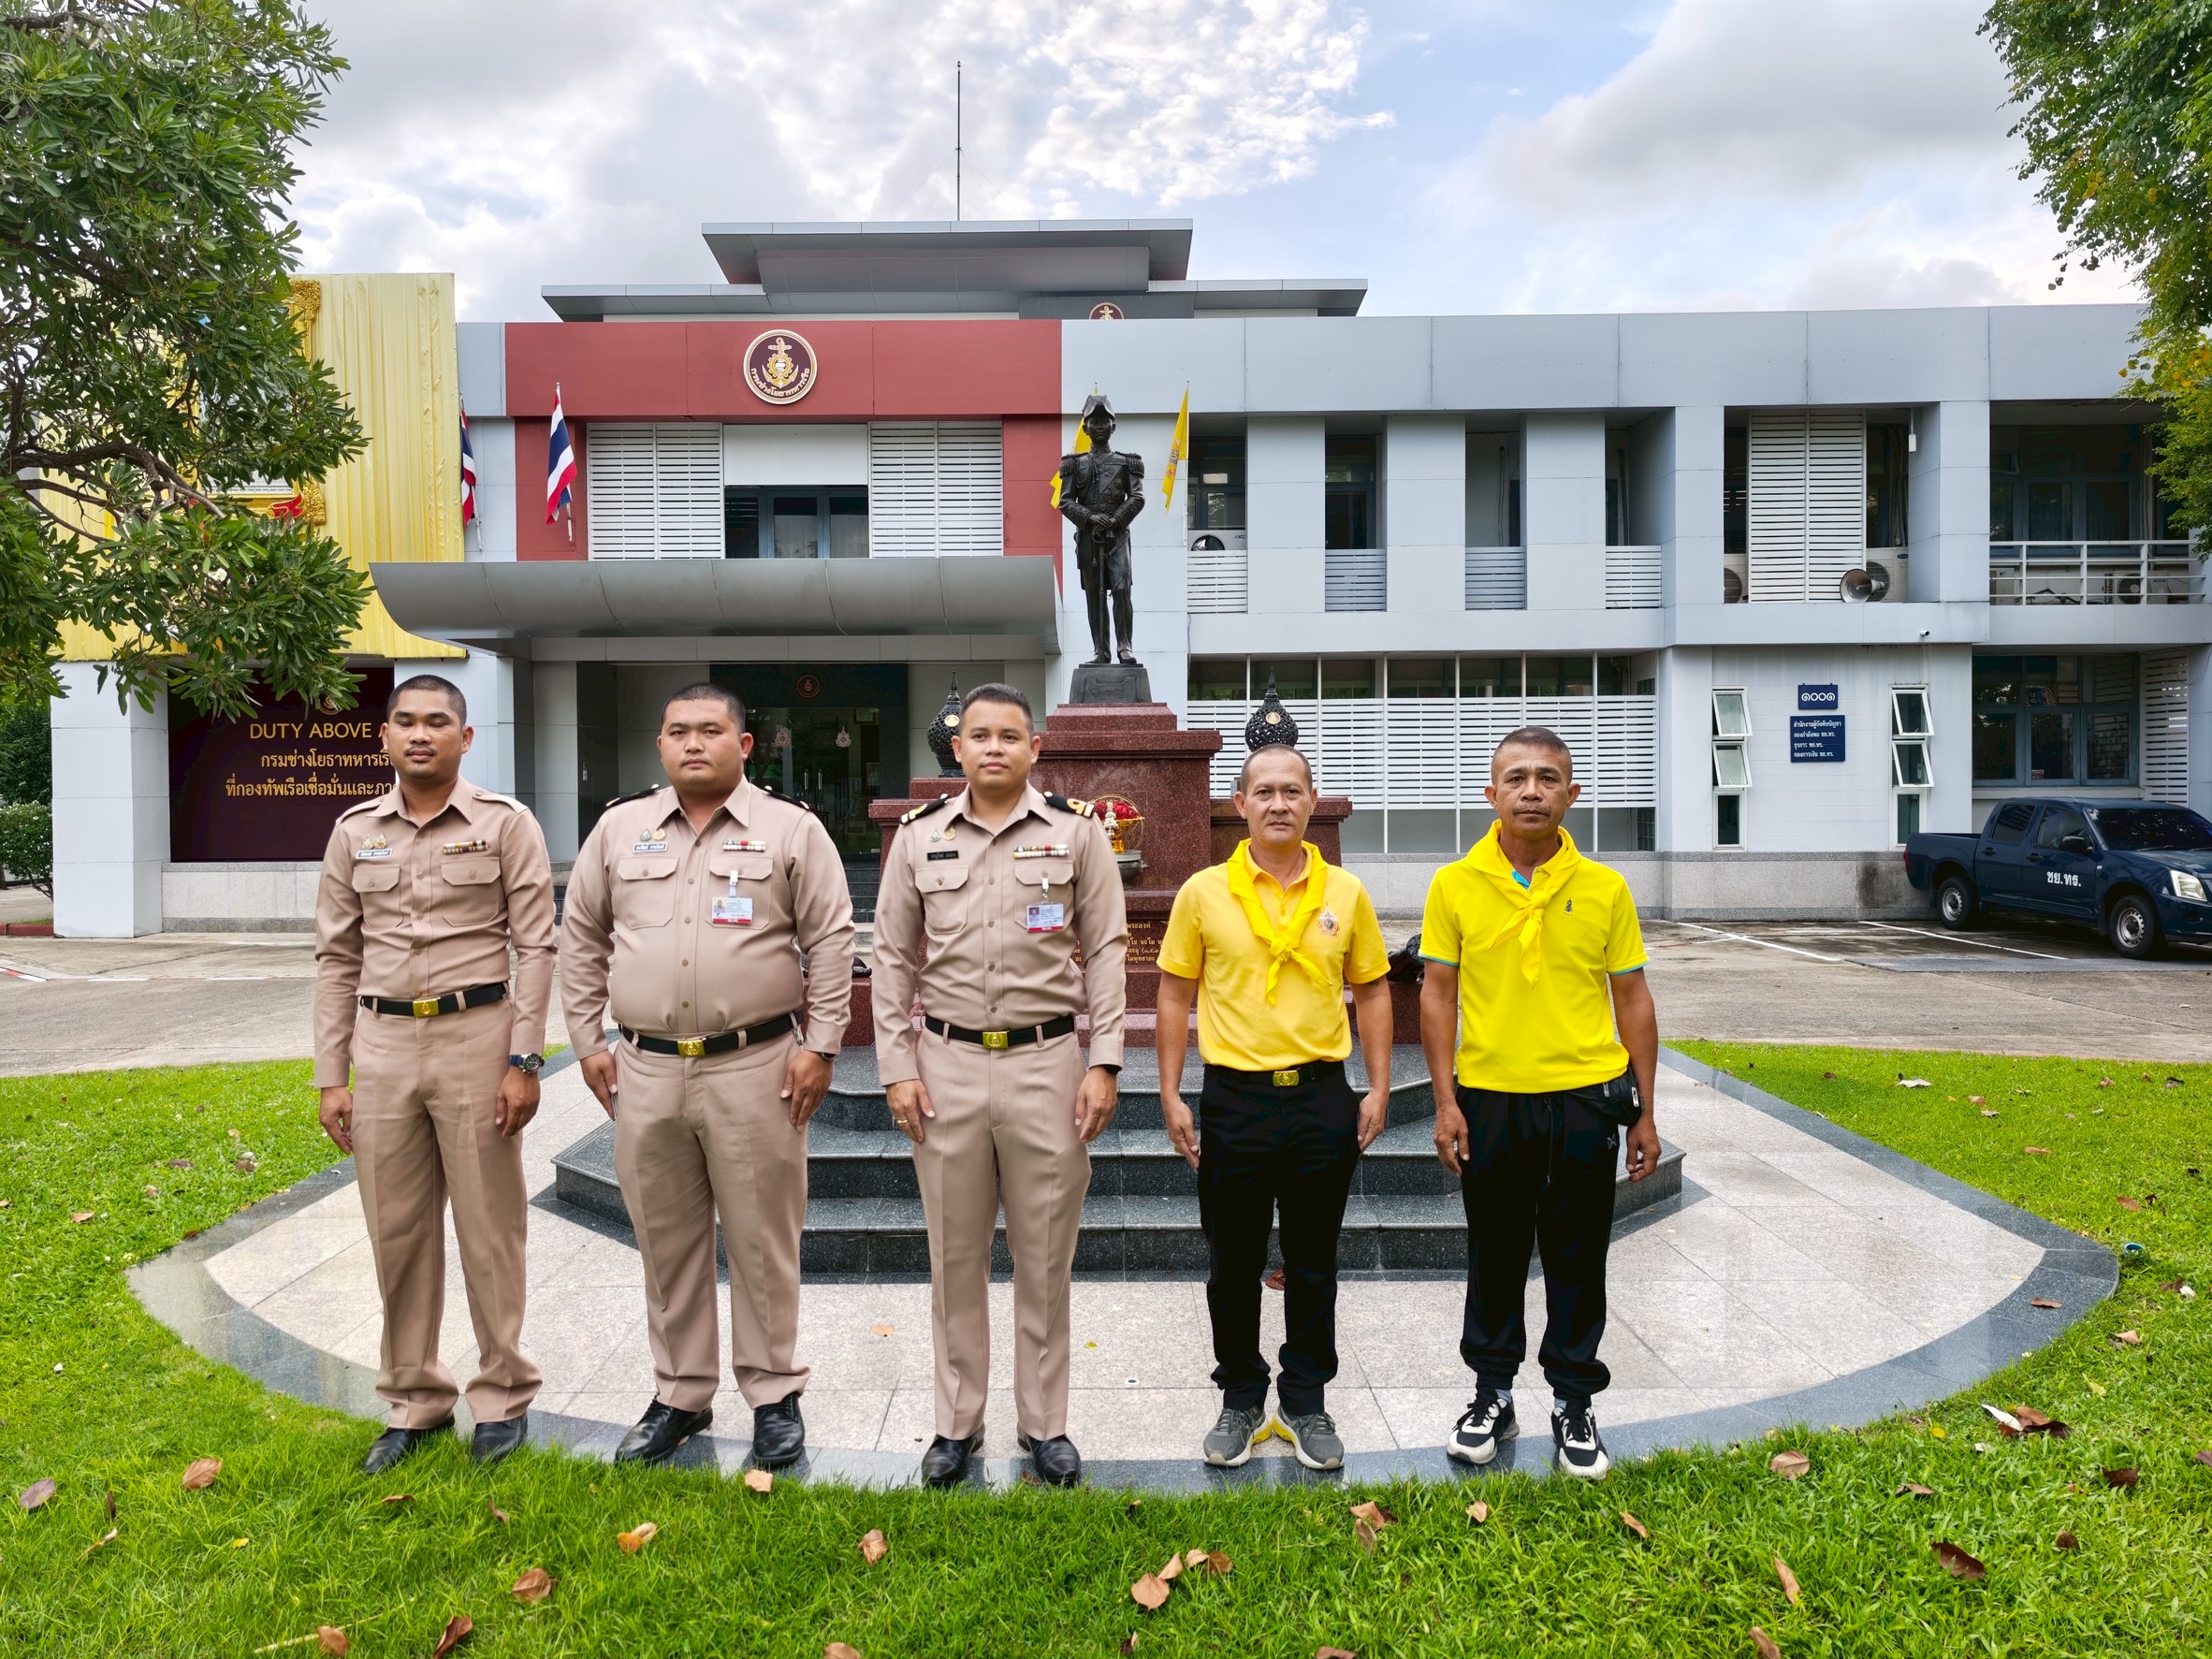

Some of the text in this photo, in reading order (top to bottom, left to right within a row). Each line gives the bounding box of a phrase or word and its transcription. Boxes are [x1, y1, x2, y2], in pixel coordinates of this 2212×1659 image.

[1801, 692, 1836, 702] ๑๐๐๑
[249, 722, 303, 739] DUTY
[309, 722, 372, 738] ABOVE
[2046, 871, 2082, 887] ชย.ทร.
